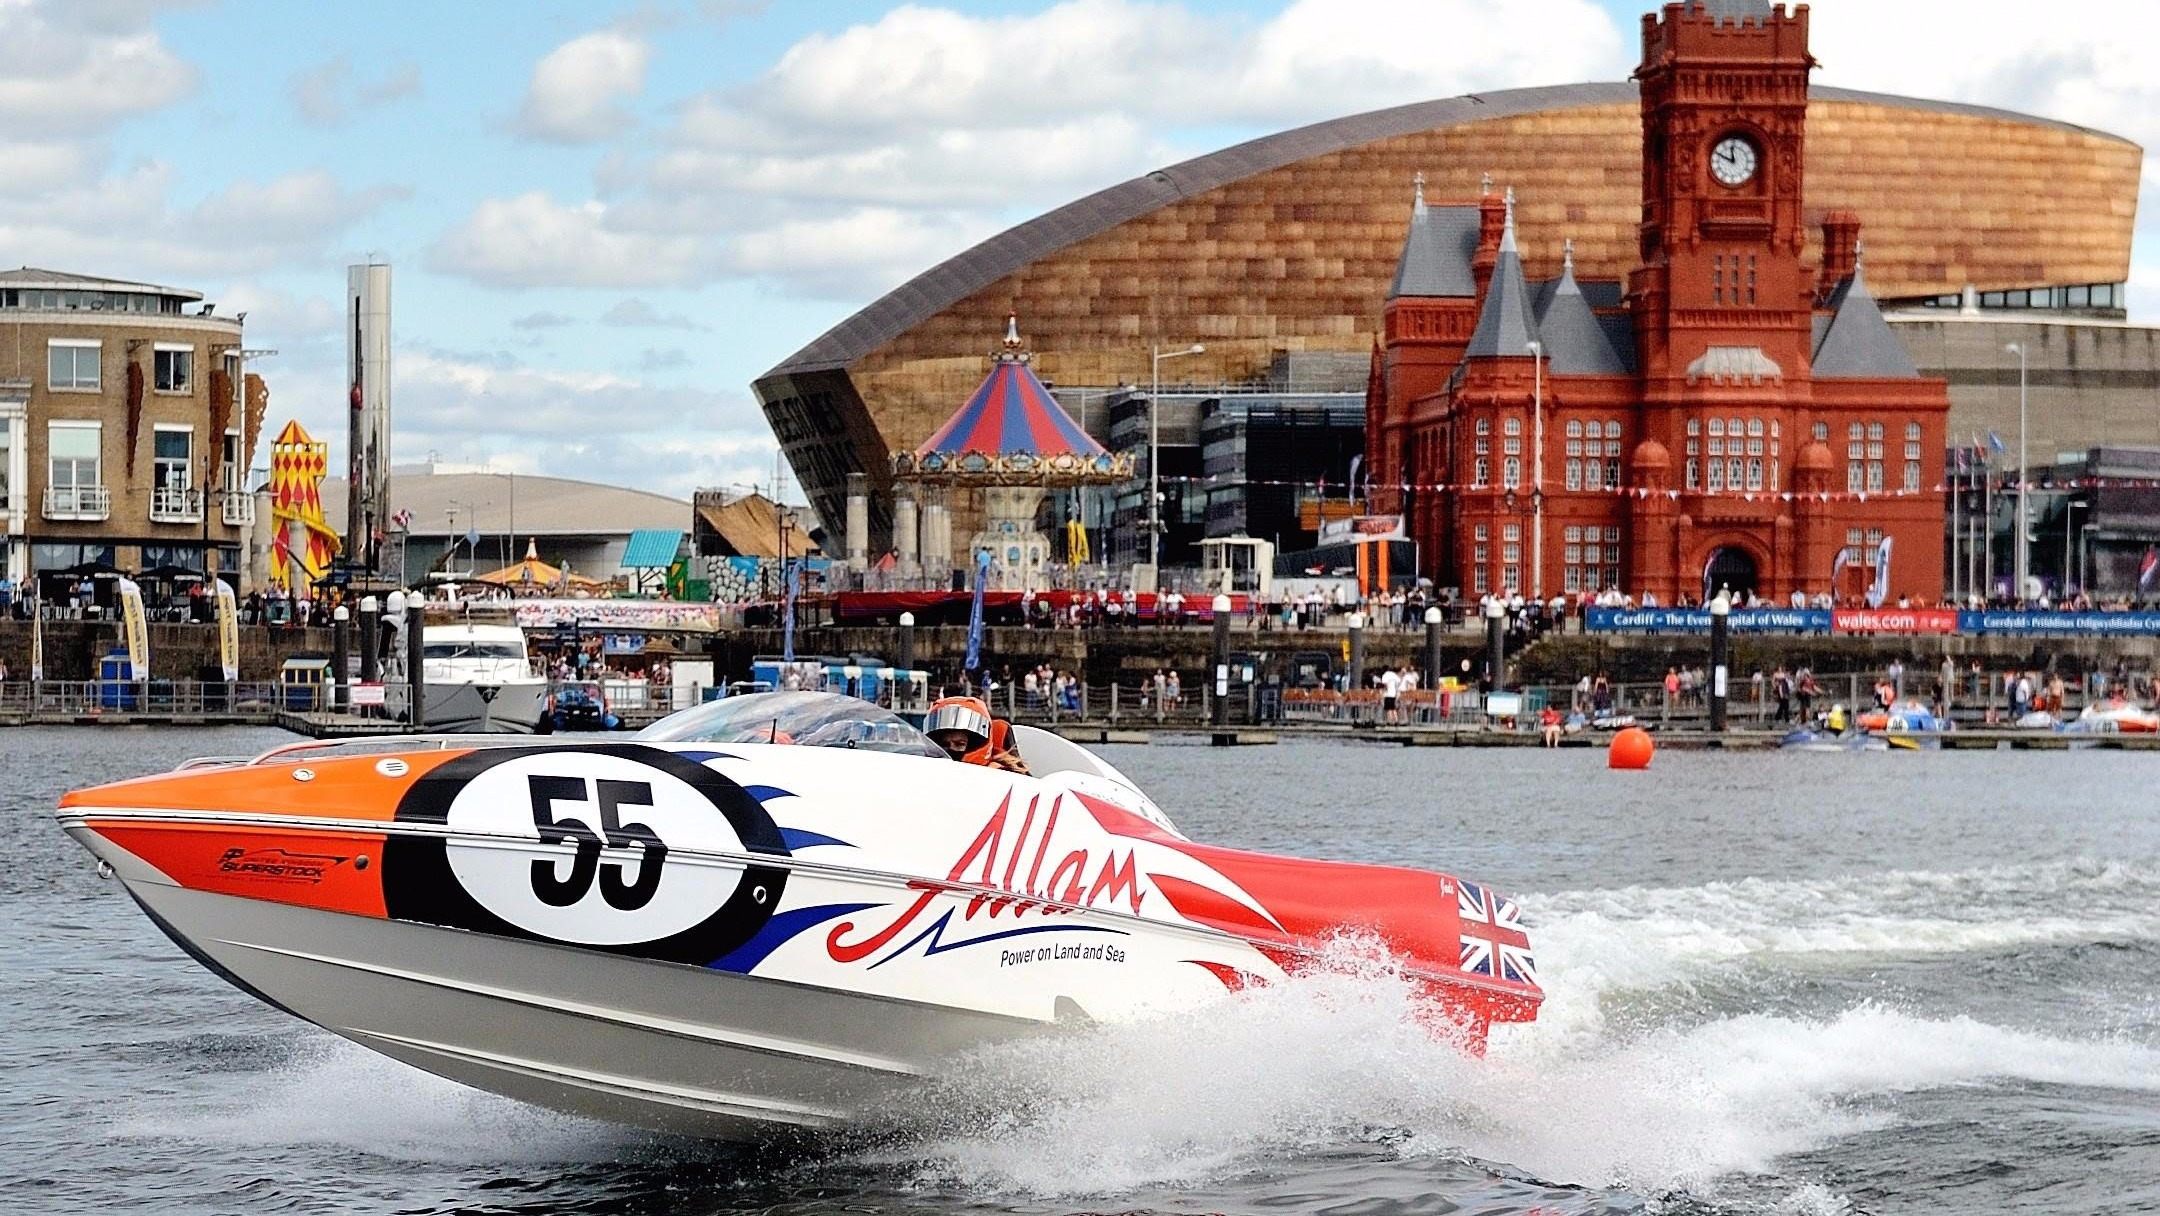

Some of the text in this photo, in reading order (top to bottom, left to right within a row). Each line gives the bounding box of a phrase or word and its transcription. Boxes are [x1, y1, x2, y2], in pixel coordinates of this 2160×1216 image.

[1613, 612, 1655, 626] Cardiff
[1665, 612, 1685, 626] The
[1687, 612, 1712, 626] Even
[1727, 612, 1755, 628] apital
[1758, 612, 1770, 626] of
[1771, 612, 1803, 626] Wales
[1837, 612, 1914, 628] wales.com
[527, 774, 668, 911] 55
[220, 861, 325, 877] SUPERSTOCK
[826, 783, 1146, 963] Allam
[1000, 942, 1125, 968] Power on Land and Sea
